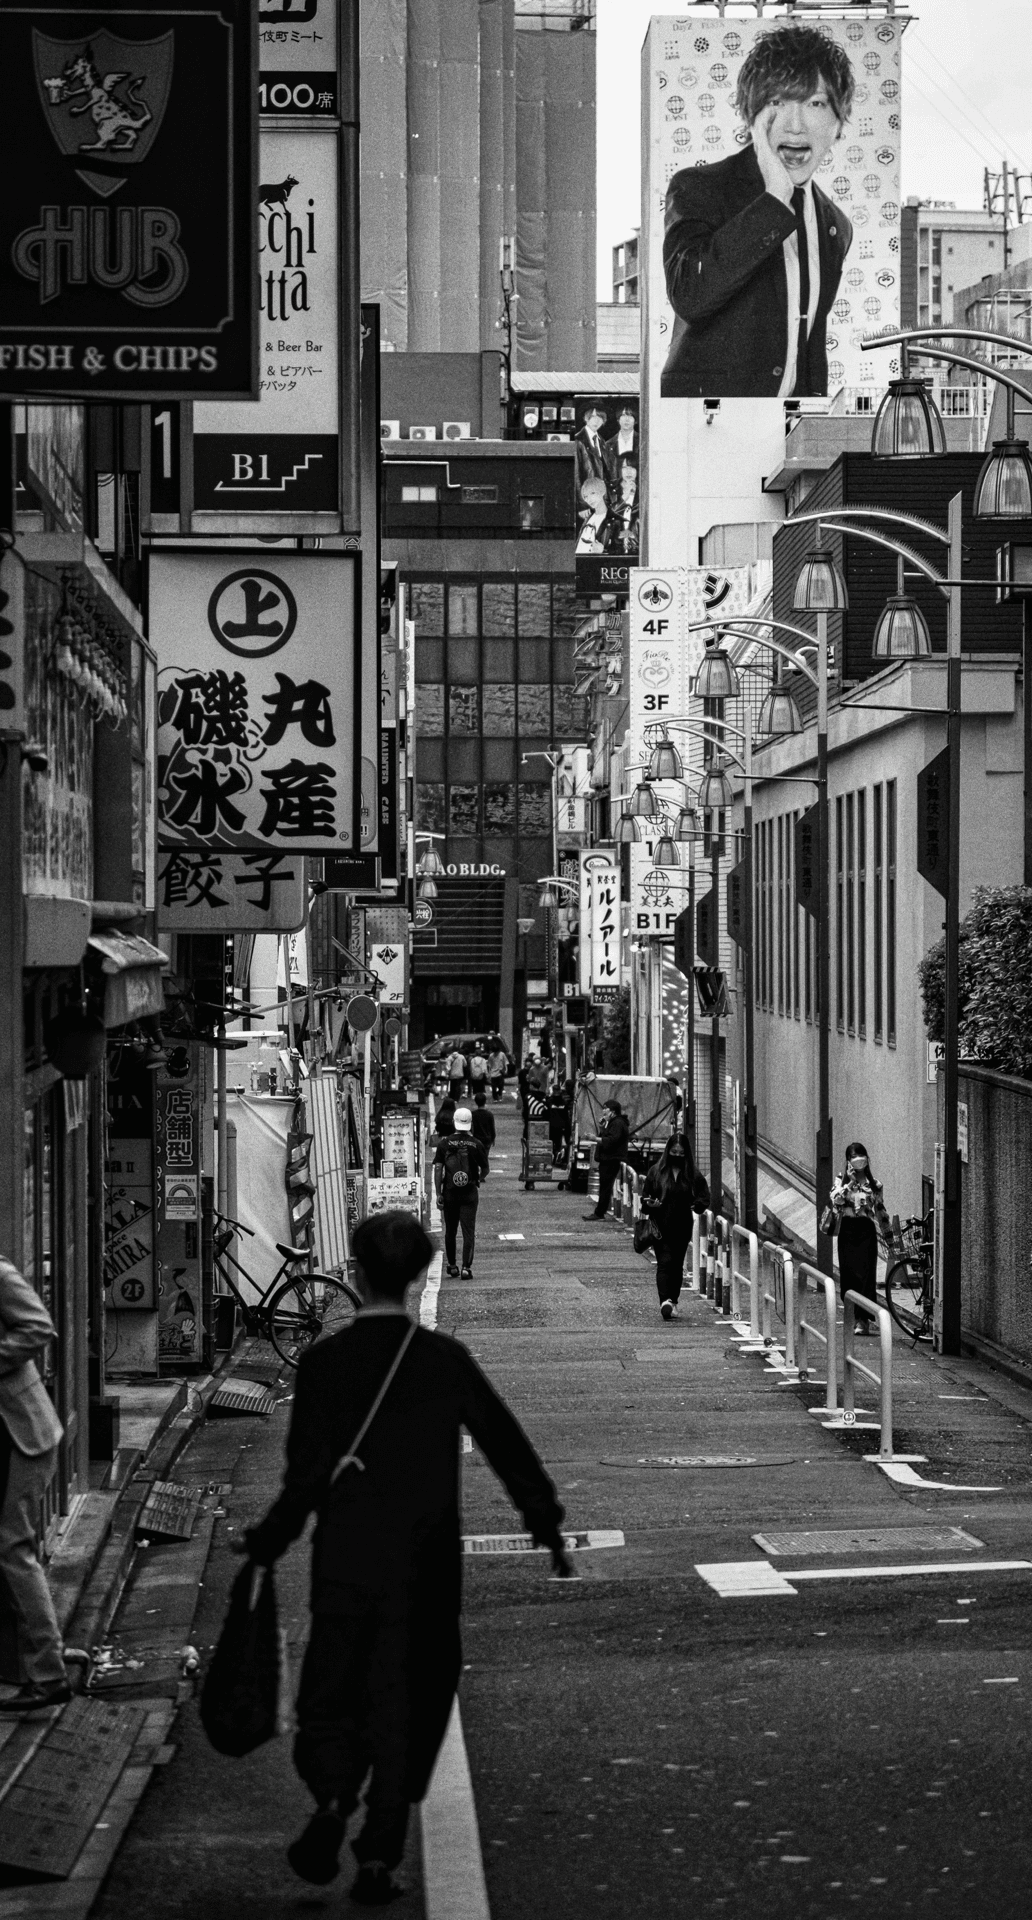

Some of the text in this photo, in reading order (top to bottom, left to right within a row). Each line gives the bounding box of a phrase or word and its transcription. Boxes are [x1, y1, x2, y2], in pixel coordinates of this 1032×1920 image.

[259, 30, 324, 43] 伎町ミート
[11, 206, 189, 308] HUB
[265, 339, 323, 352] & Beer Bar
[0, 345, 218, 375] FISH & CHIPS
[280, 365, 322, 377] ビアバー
[154, 410, 171, 478] 1
[231, 453, 271, 480] B1
[600, 567, 630, 580] REG
[642, 619, 669, 635] 4F
[172, 669, 337, 748] 磯丸
[643, 694, 670, 710] 3F
[381, 732, 390, 825] HAUNTED CAFE
[168, 758, 338, 838] 水産
[460, 863, 506, 876] BLDG.
[158, 852, 295, 911] 餃子
[637, 913, 677, 929] B1F
[599, 888, 617, 977] ルノアール
[564, 983, 579, 997] B1
[165, 1089, 193, 1167] 店舗型
[123, 1283, 142, 1298] 2F
